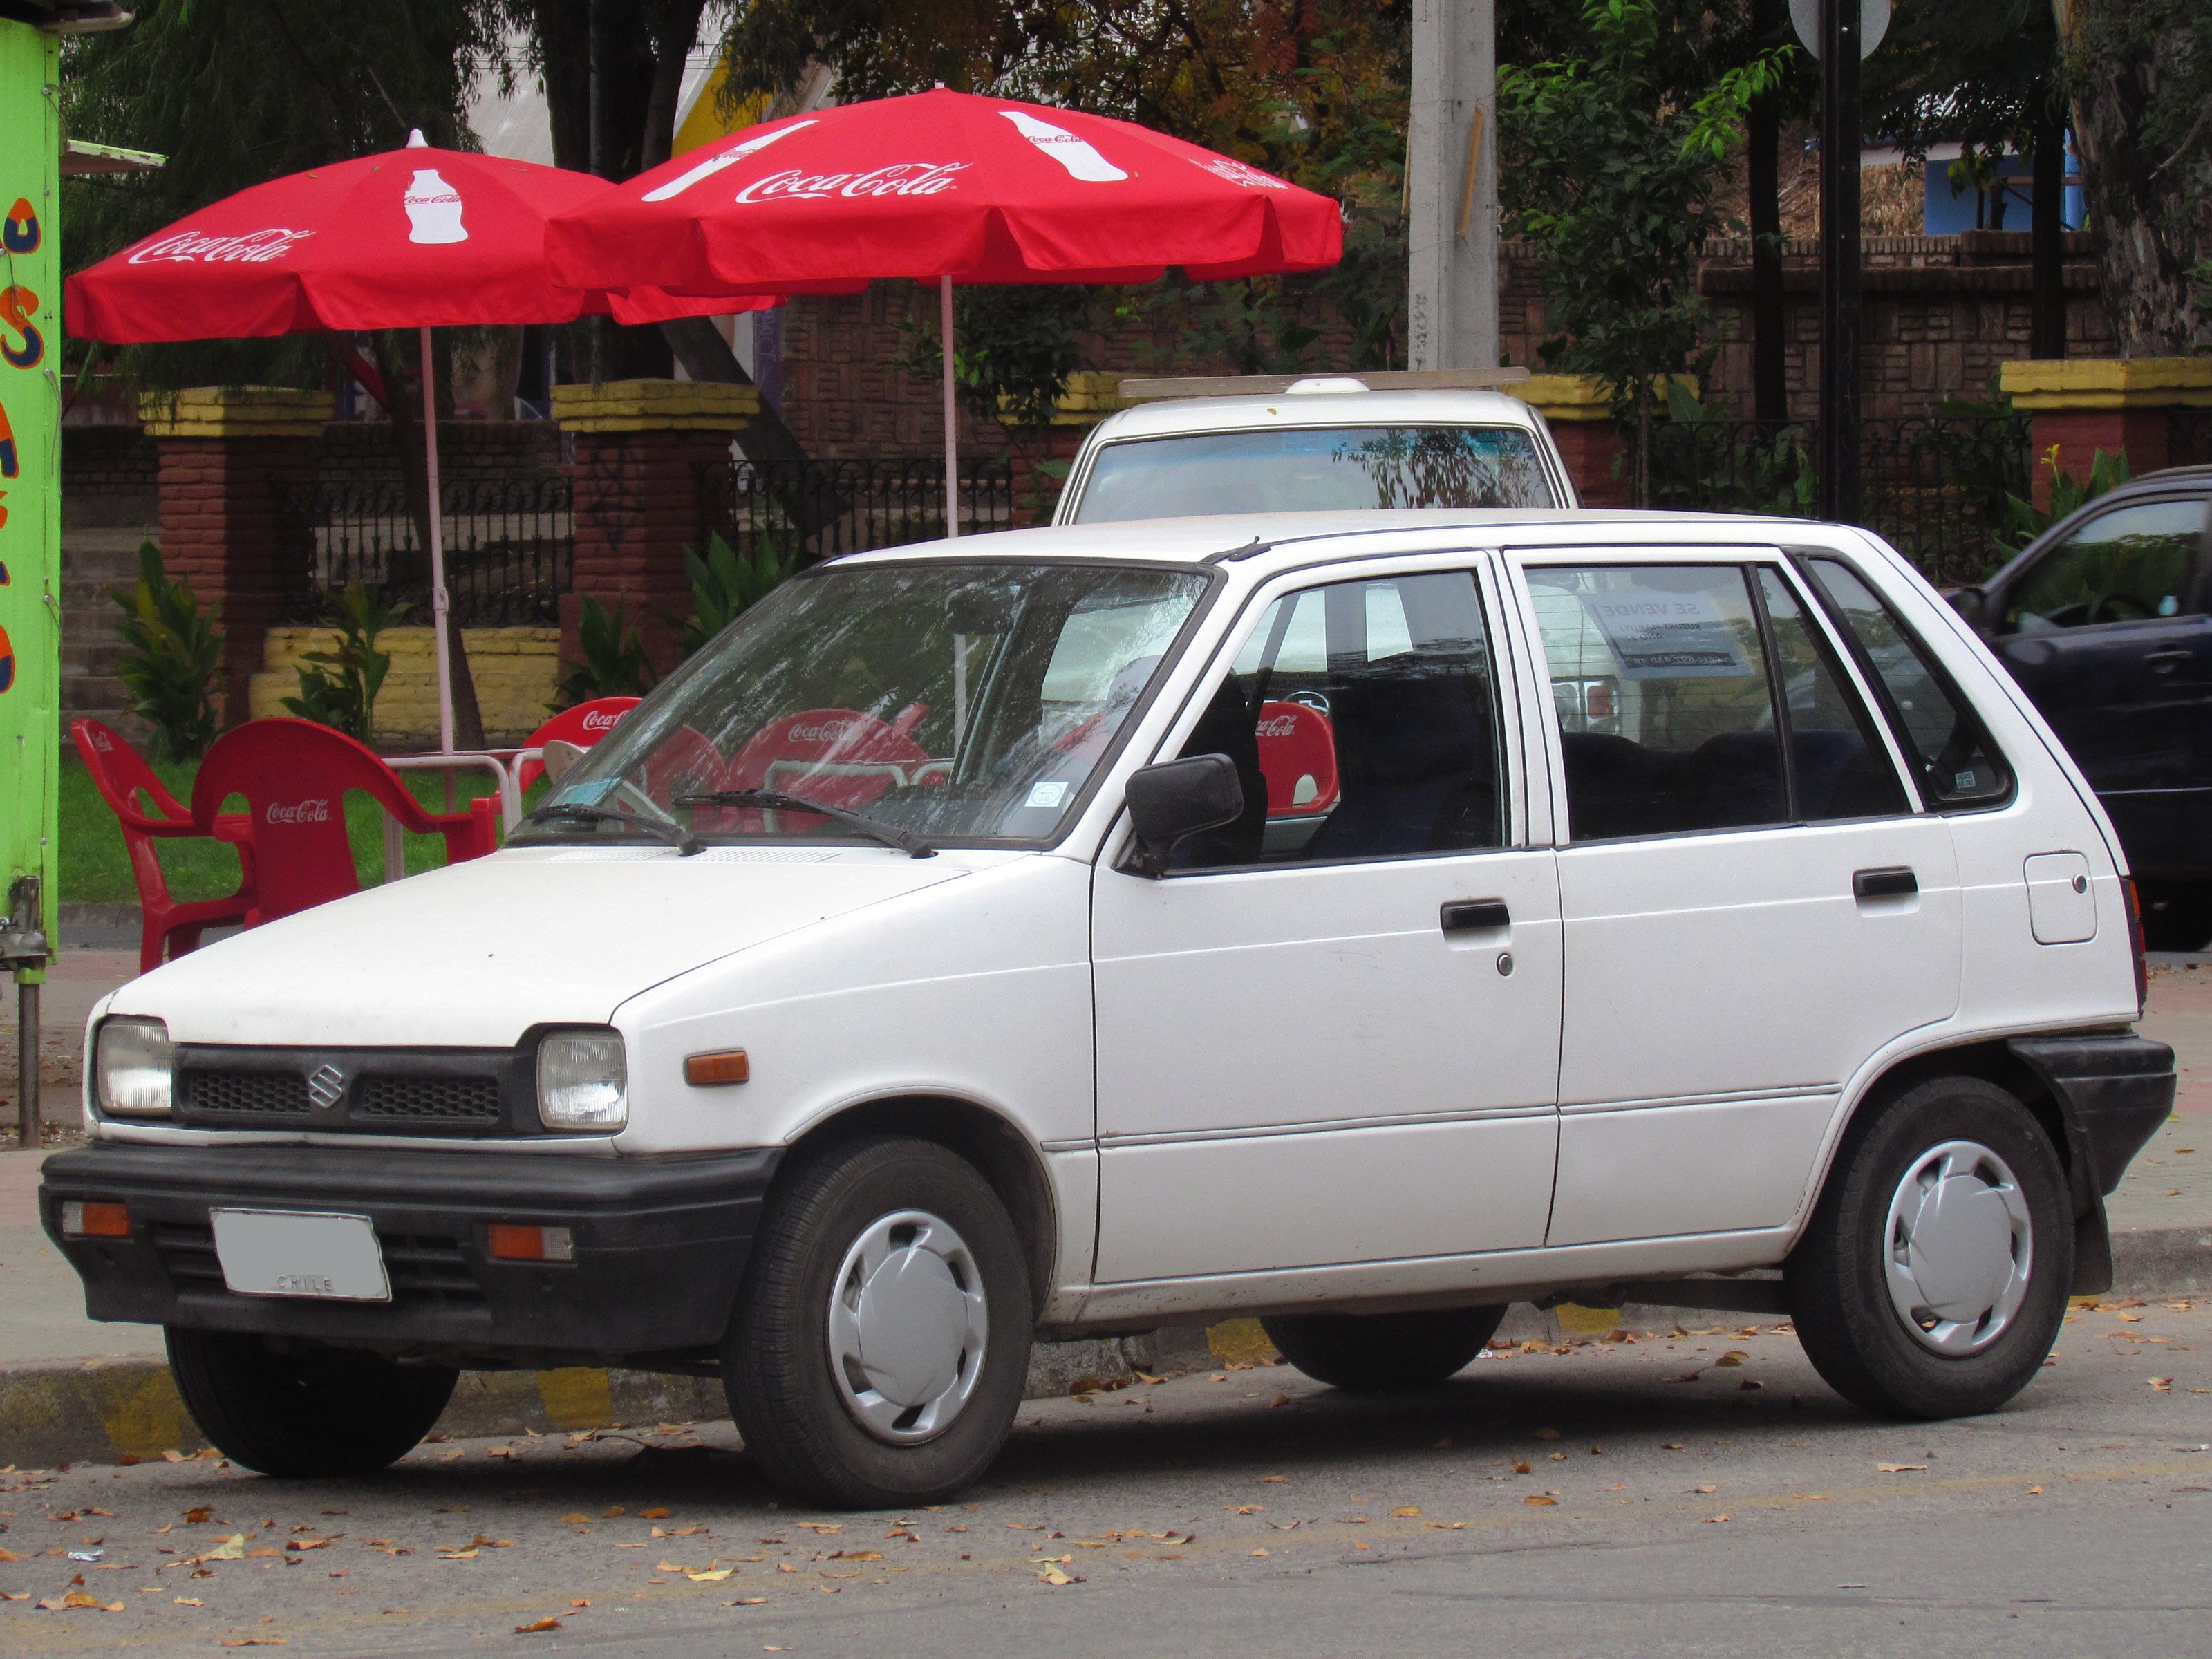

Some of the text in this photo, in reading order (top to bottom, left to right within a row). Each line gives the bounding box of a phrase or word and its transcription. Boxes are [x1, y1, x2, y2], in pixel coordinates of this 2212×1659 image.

[735, 162, 973, 204] Coca-Cola
[128, 229, 317, 264] Coca-Cola
[583, 710, 630, 731] Coca-C
[266, 799, 328, 824] Coca-Cola
[277, 1274, 332, 1291] CHILE
